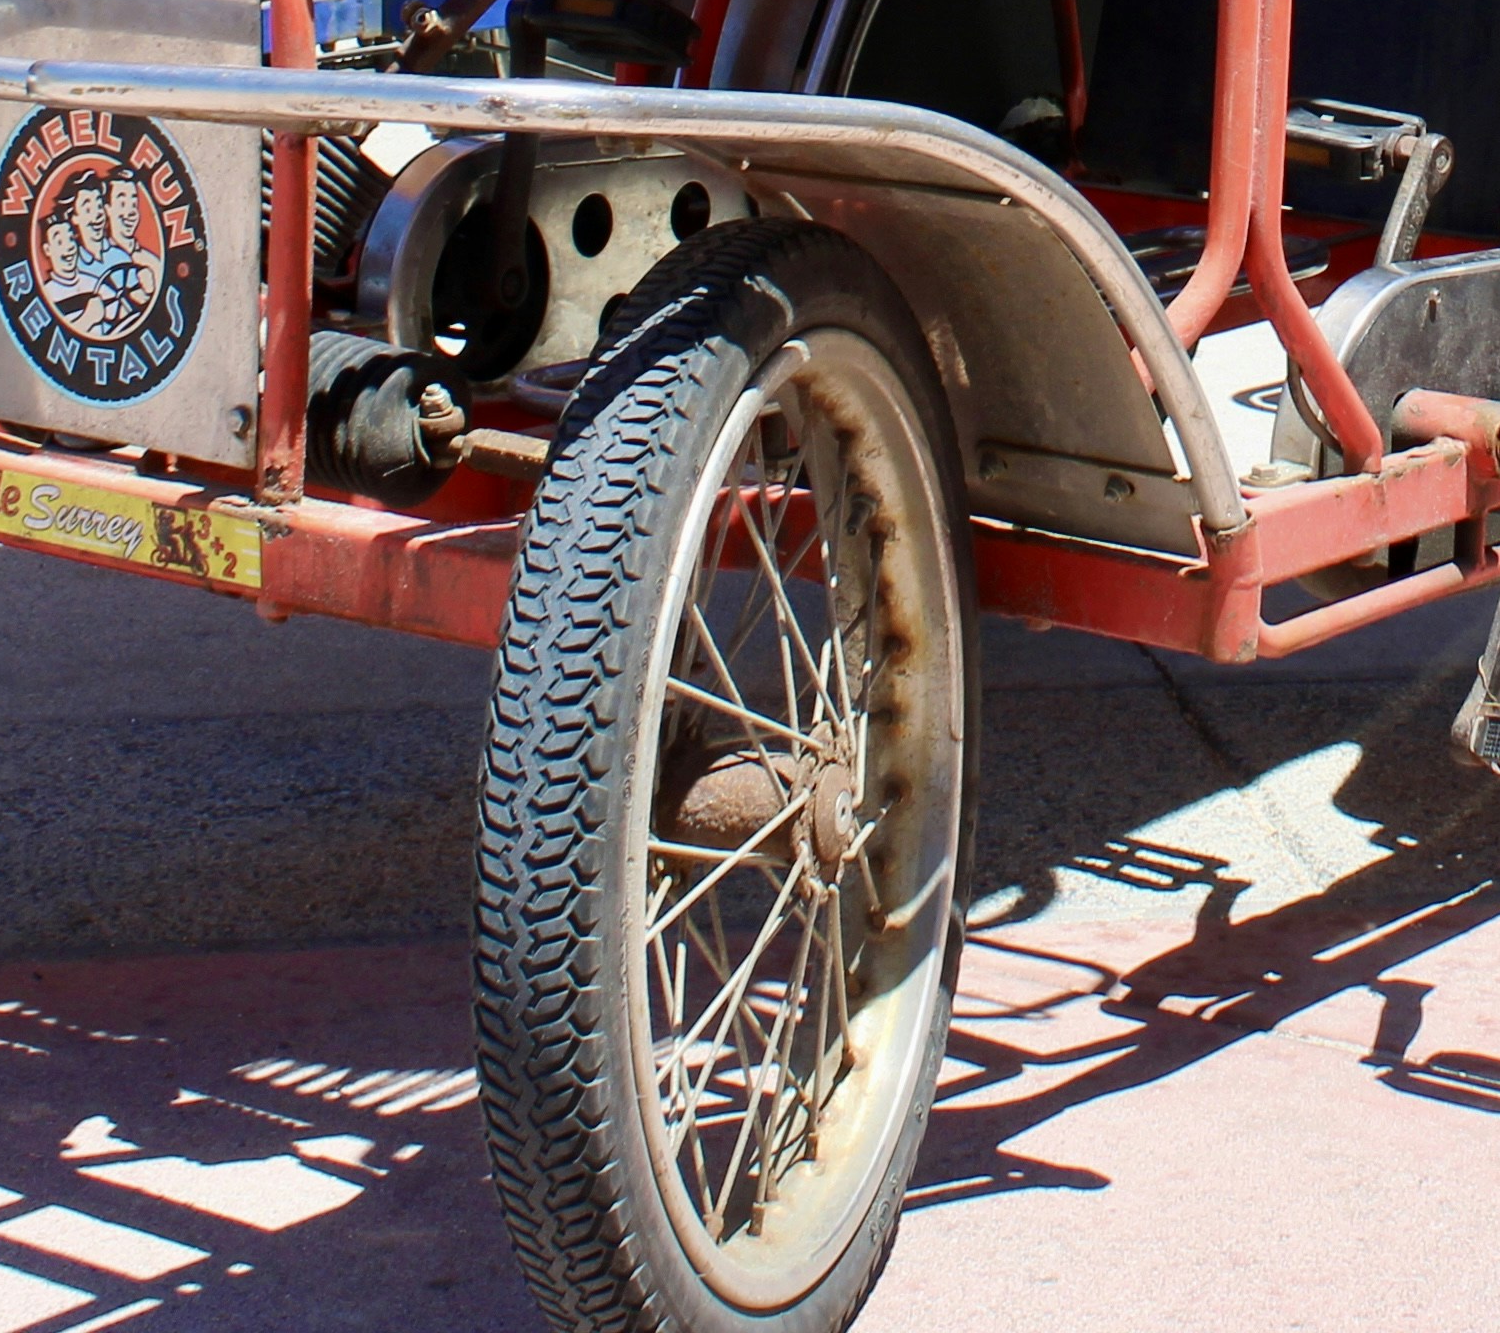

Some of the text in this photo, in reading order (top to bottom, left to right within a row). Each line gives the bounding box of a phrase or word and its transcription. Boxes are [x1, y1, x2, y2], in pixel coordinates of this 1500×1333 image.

[1, 109, 196, 249] WHEEL FUN
[3, 259, 185, 386] RENTALS
[22, 484, 145, 559] Surrey
